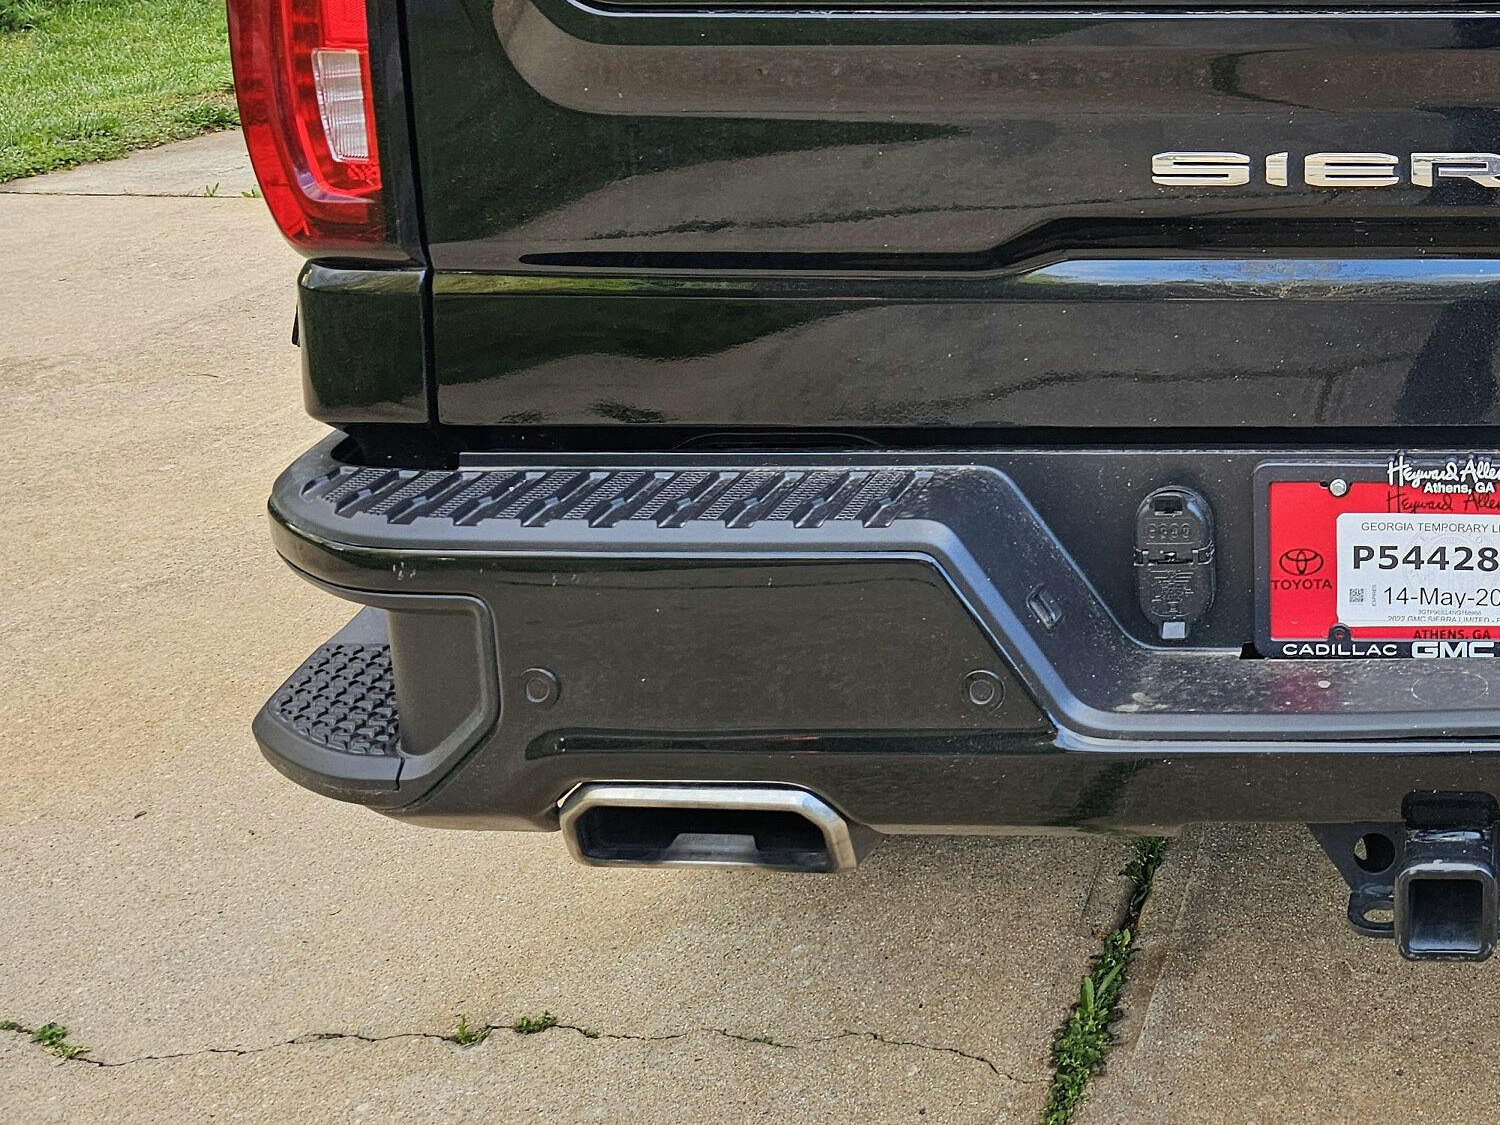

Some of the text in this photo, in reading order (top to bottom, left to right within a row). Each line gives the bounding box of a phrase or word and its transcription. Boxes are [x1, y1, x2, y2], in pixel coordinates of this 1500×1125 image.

[1387, 455, 1459, 488] Heyward
[1424, 482, 1495, 495] Athens, GA
[1361, 522, 1414, 532] GEORGIA
[1418, 523, 1489, 534] TEMPORARY
[1270, 579, 1333, 590] TOYOTA
[1472, 629, 1491, 639] GA
[1282, 644, 1398, 656] CADILLAC
[1411, 641, 1495, 658] GMC
